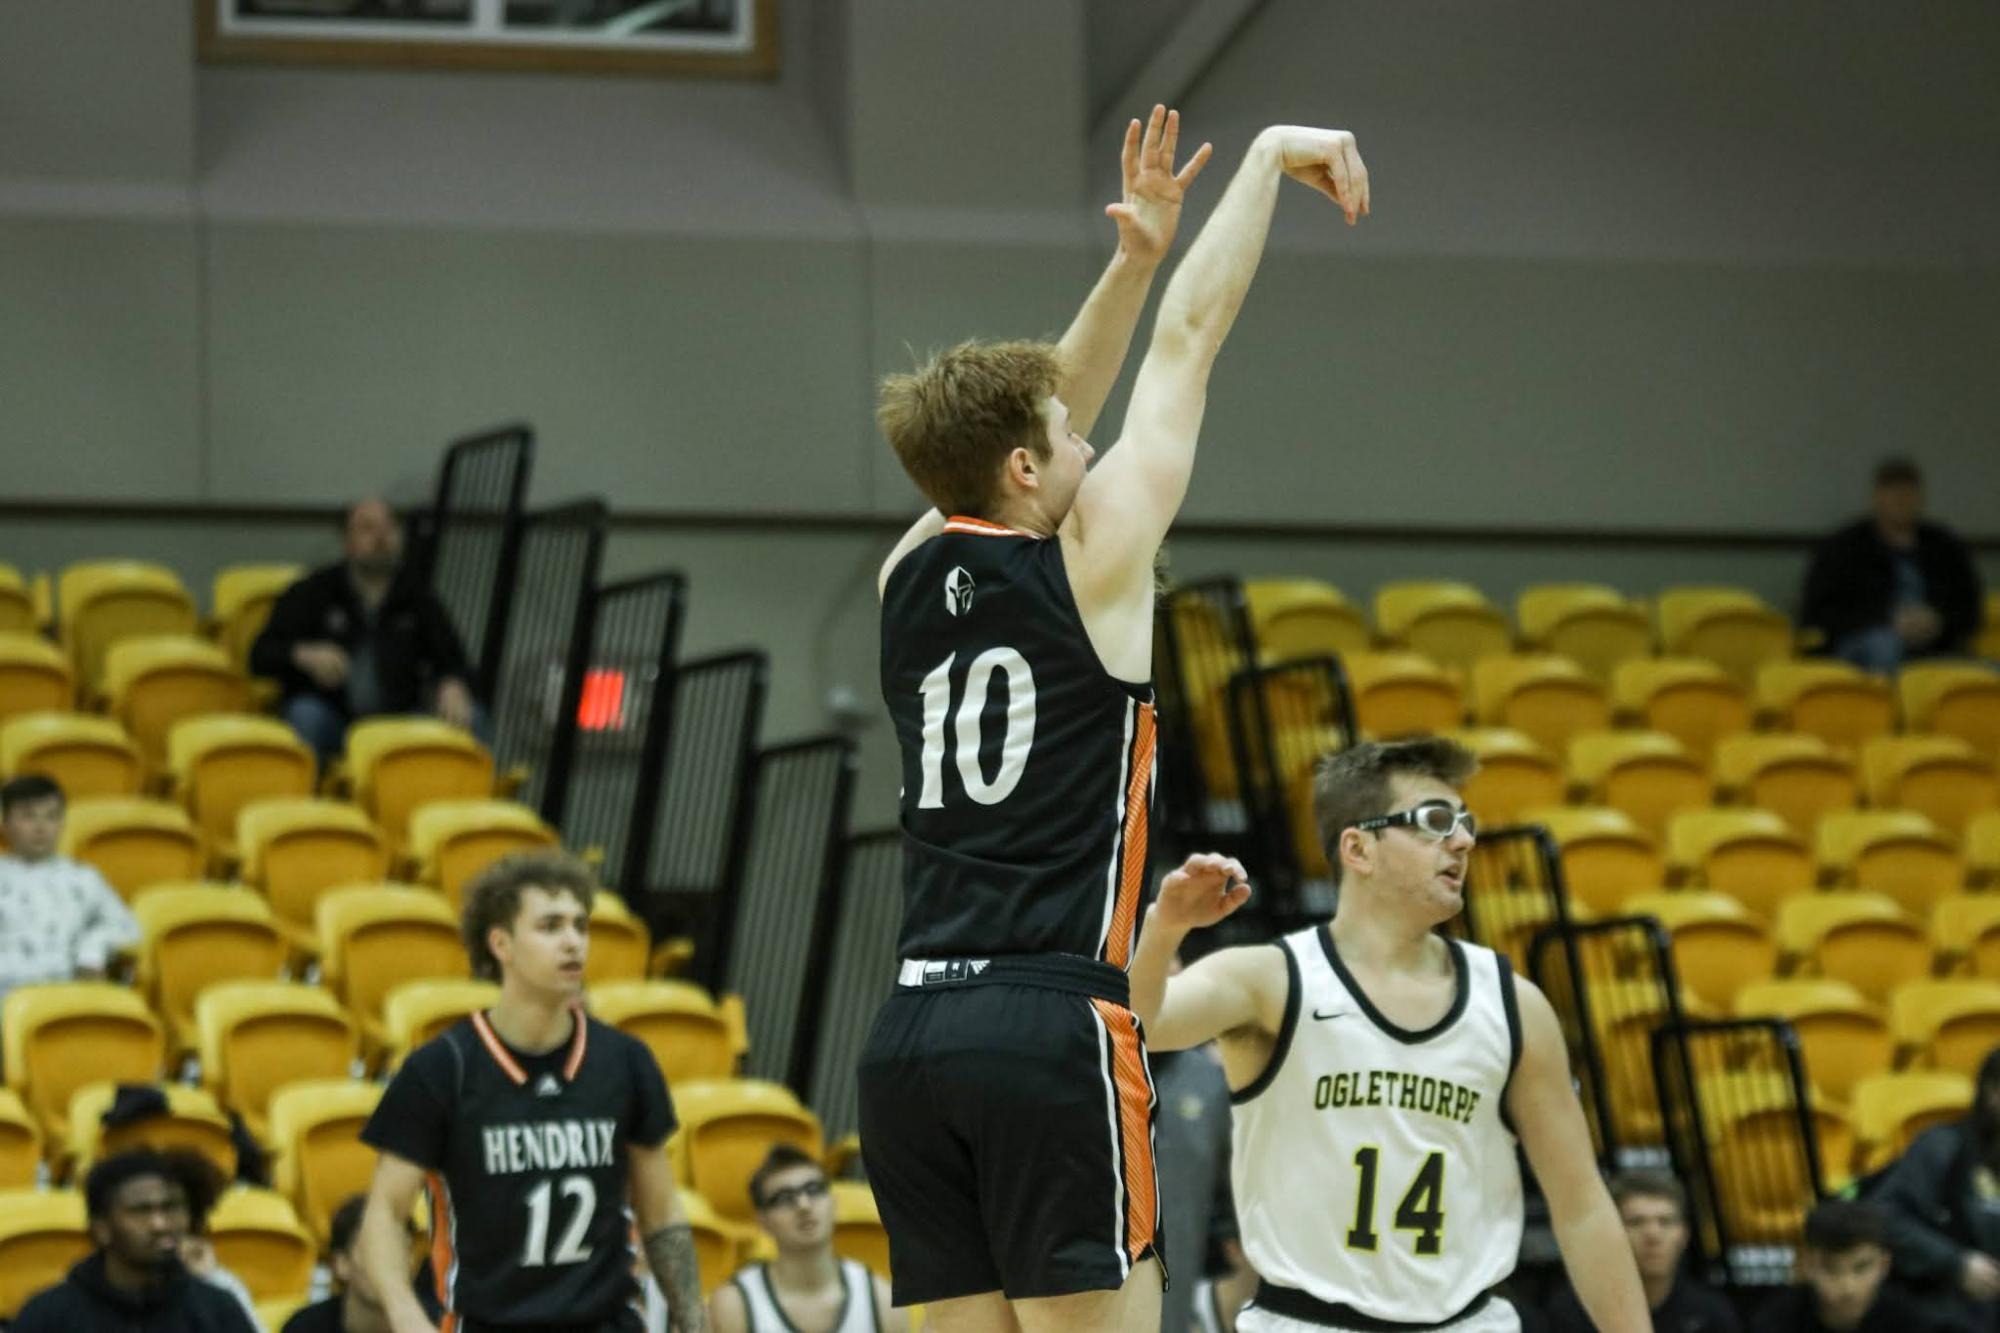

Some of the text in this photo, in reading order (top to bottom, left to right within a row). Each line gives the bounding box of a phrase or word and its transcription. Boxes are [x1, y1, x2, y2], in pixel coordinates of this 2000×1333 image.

[918, 646, 1036, 809] 10
[1314, 1069, 1480, 1124] OGLETHORPE
[483, 1120, 616, 1175] HENDRIX
[520, 1175, 597, 1267] 12
[1346, 1146, 1445, 1256] 14
